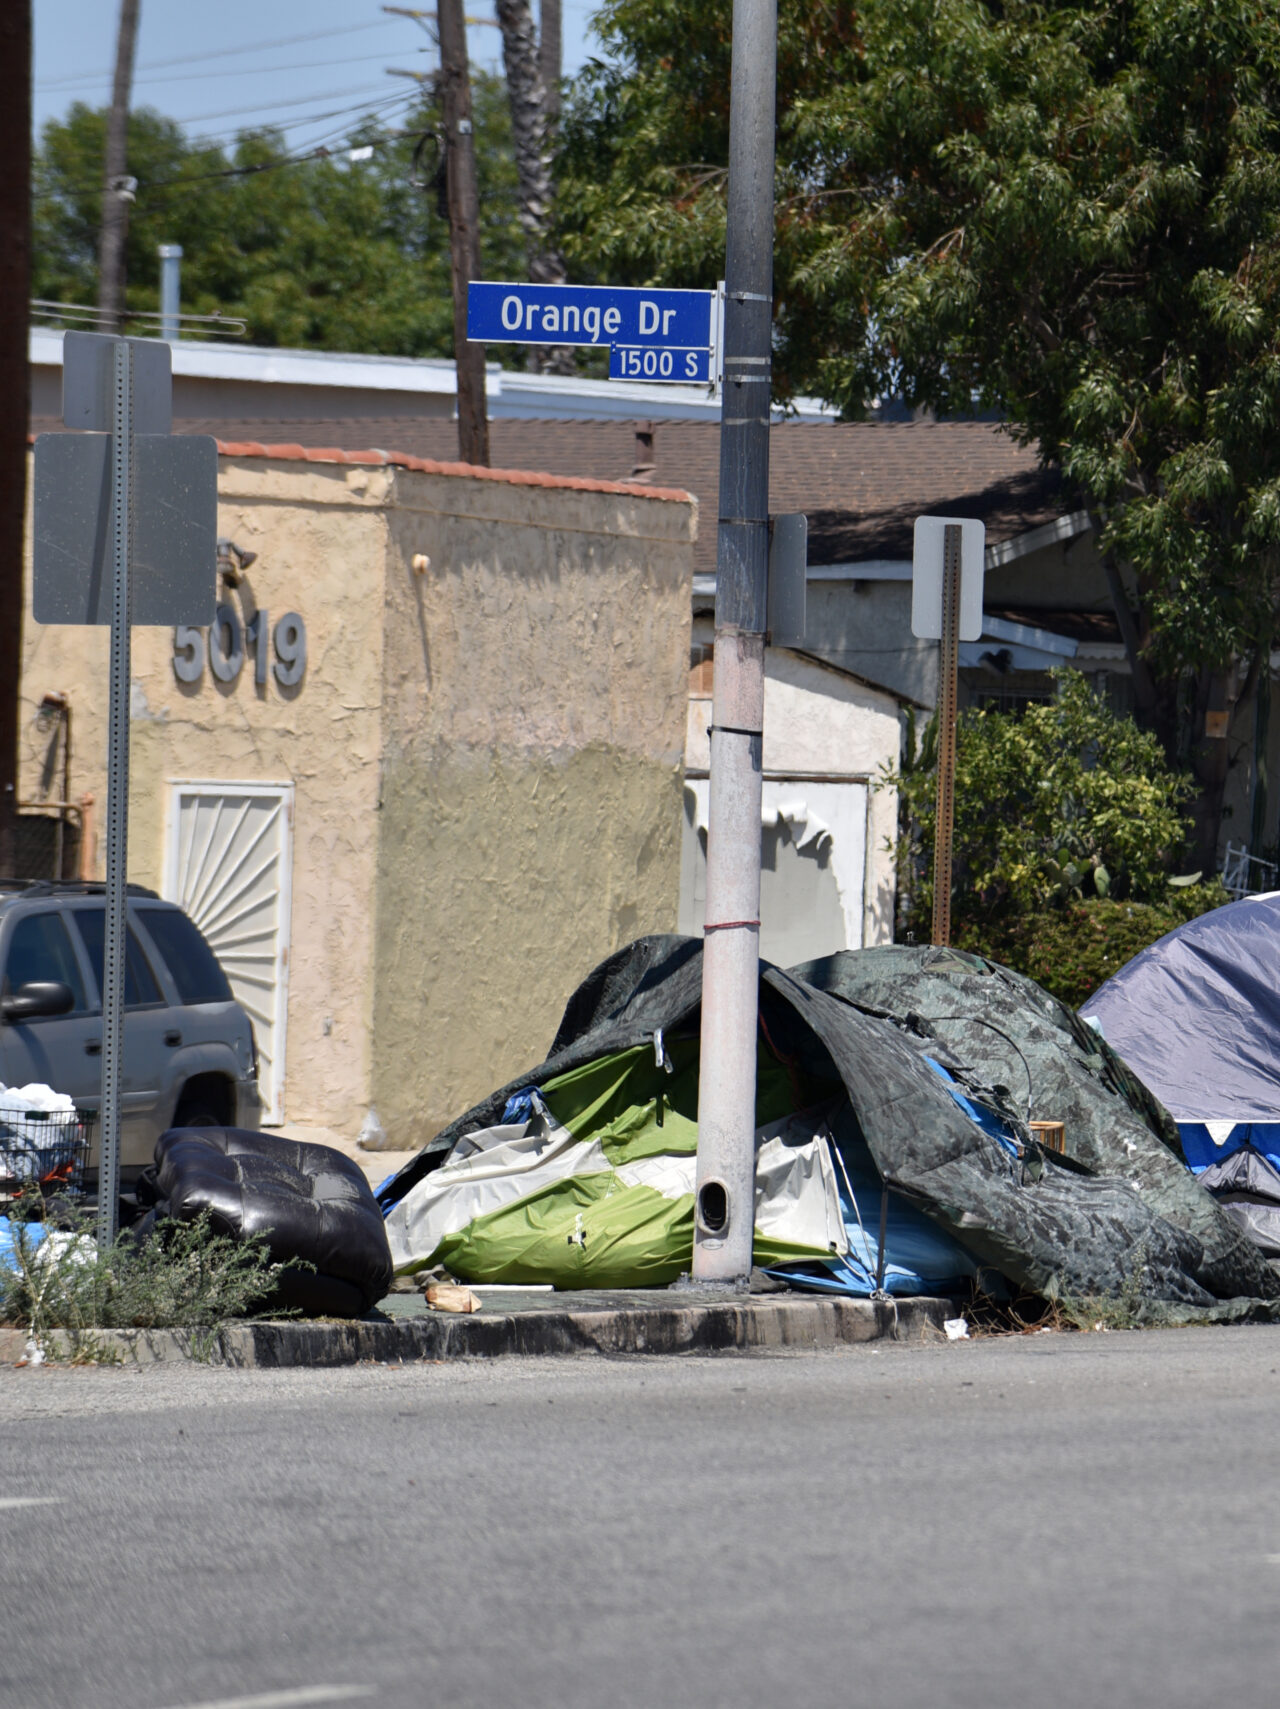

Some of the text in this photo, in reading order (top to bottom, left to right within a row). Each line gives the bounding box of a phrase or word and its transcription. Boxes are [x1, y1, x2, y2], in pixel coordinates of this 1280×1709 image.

[501, 295, 677, 343] Orange Dr
[620, 350, 698, 377] 1500 S
[172, 605, 307, 686] 5019
